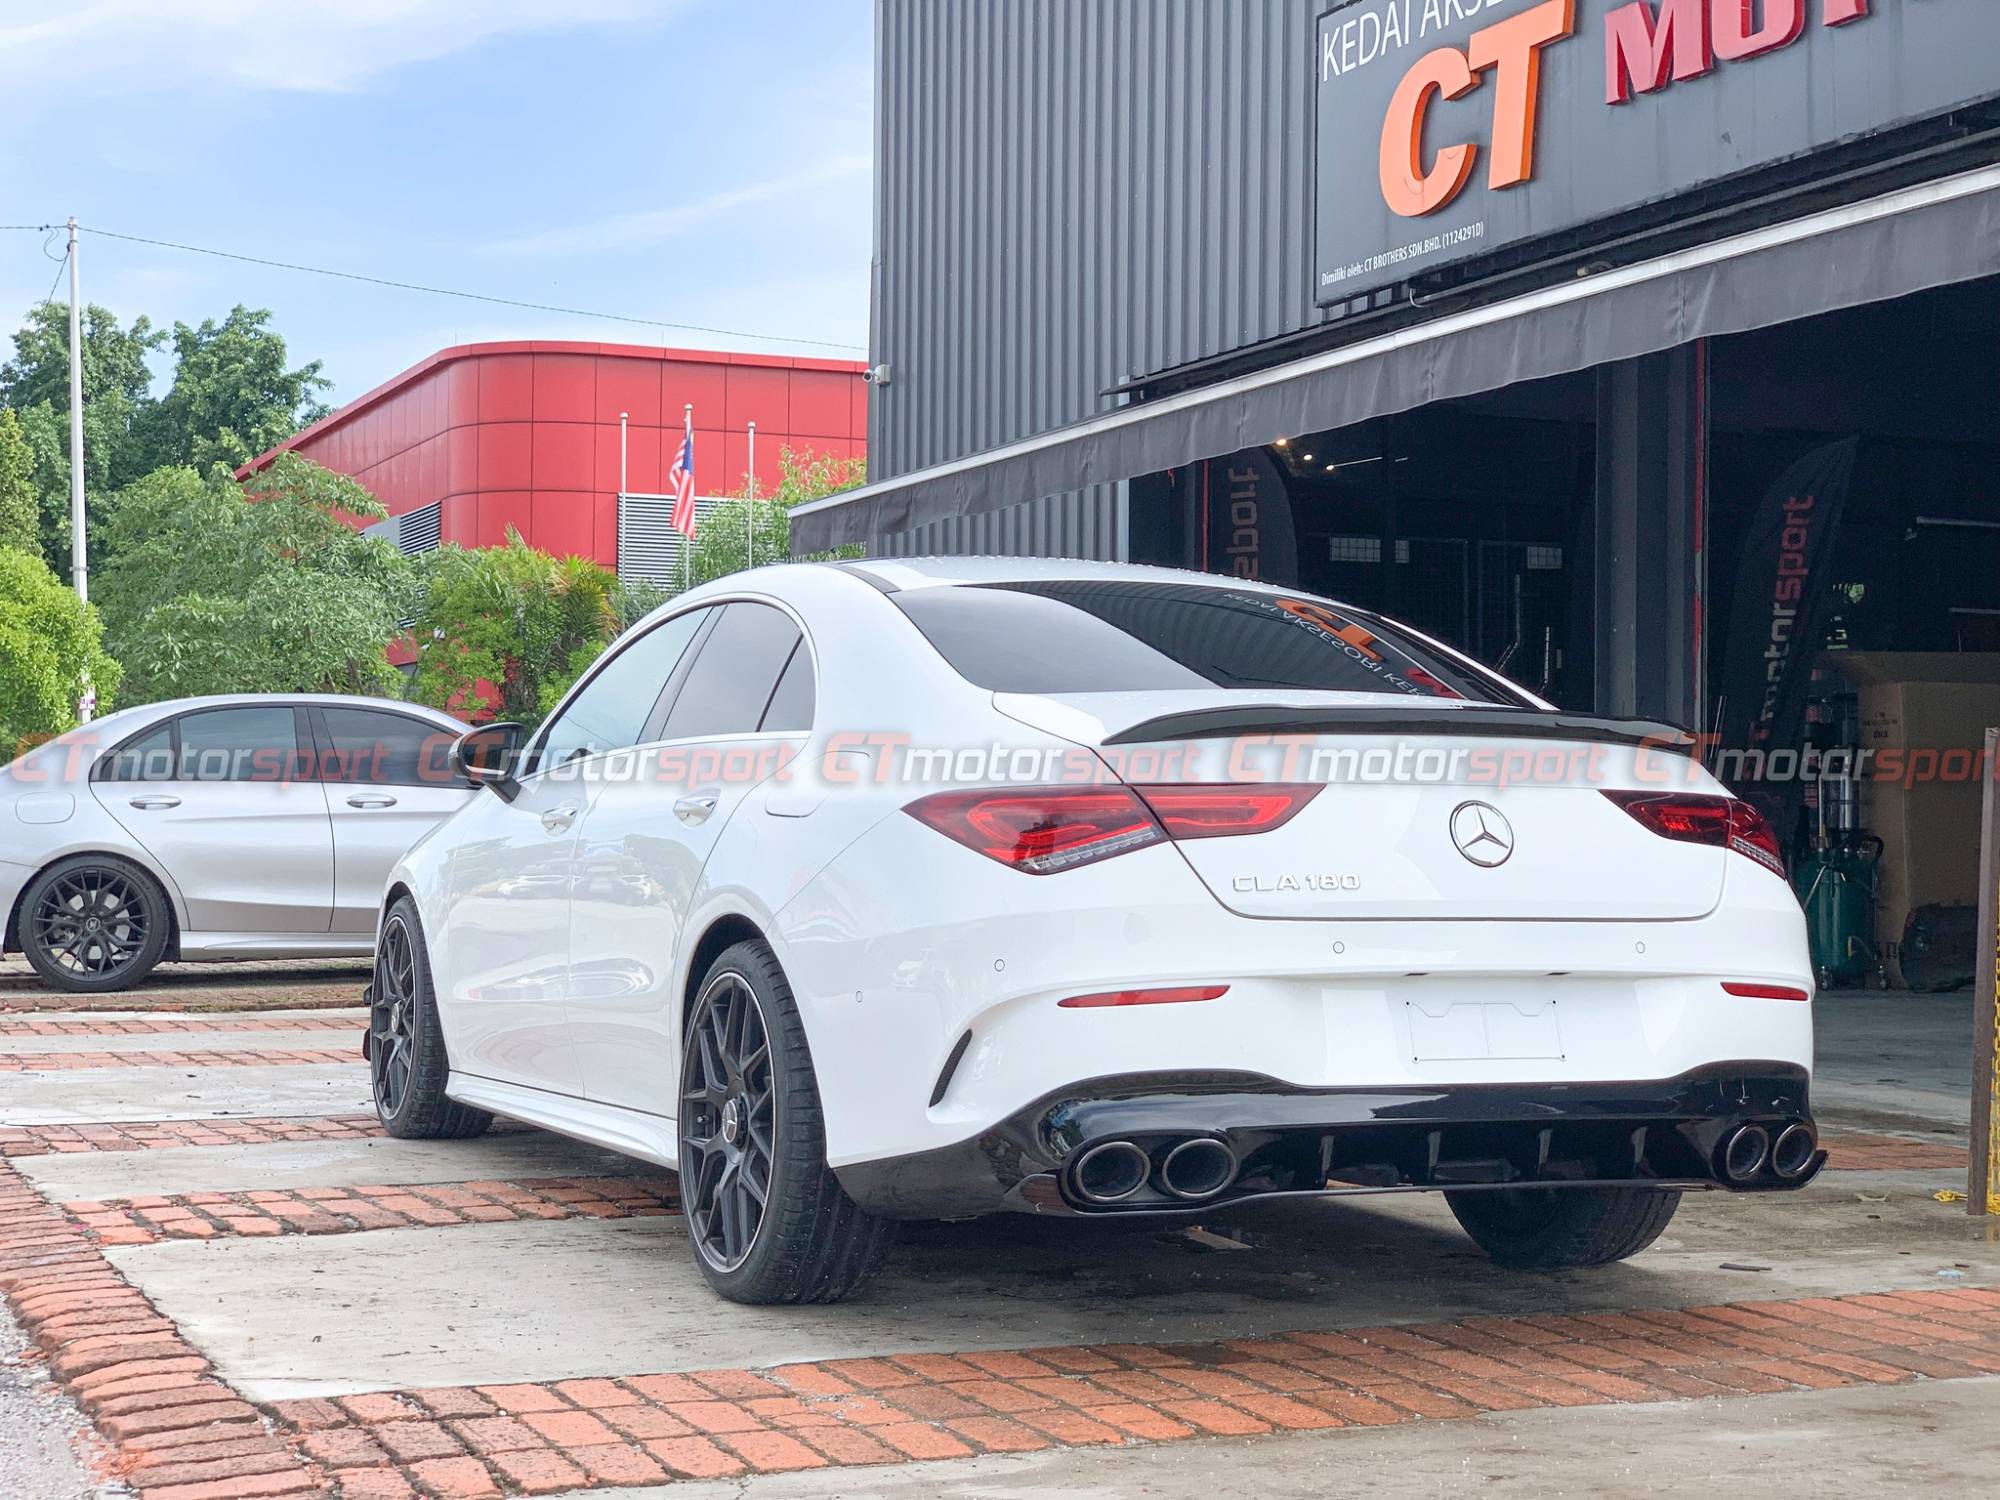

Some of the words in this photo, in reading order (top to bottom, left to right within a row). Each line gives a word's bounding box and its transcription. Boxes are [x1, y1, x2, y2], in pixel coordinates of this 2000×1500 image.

[1322, 0, 1410, 82] KEDAI
[1379, 0, 1575, 218] CT
[1603, 0, 1868, 105] MO
[1321, 265, 1347, 287] Dimiliki
[1347, 261, 1364, 278] oleh:
[1364, 257, 1374, 273] CT
[1373, 246, 1408, 270] BROTHERS
[1442, 220, 1485, 250] (1124291D)
[1232, 873, 1301, 892] CLA
[1305, 872, 1361, 891] 180
